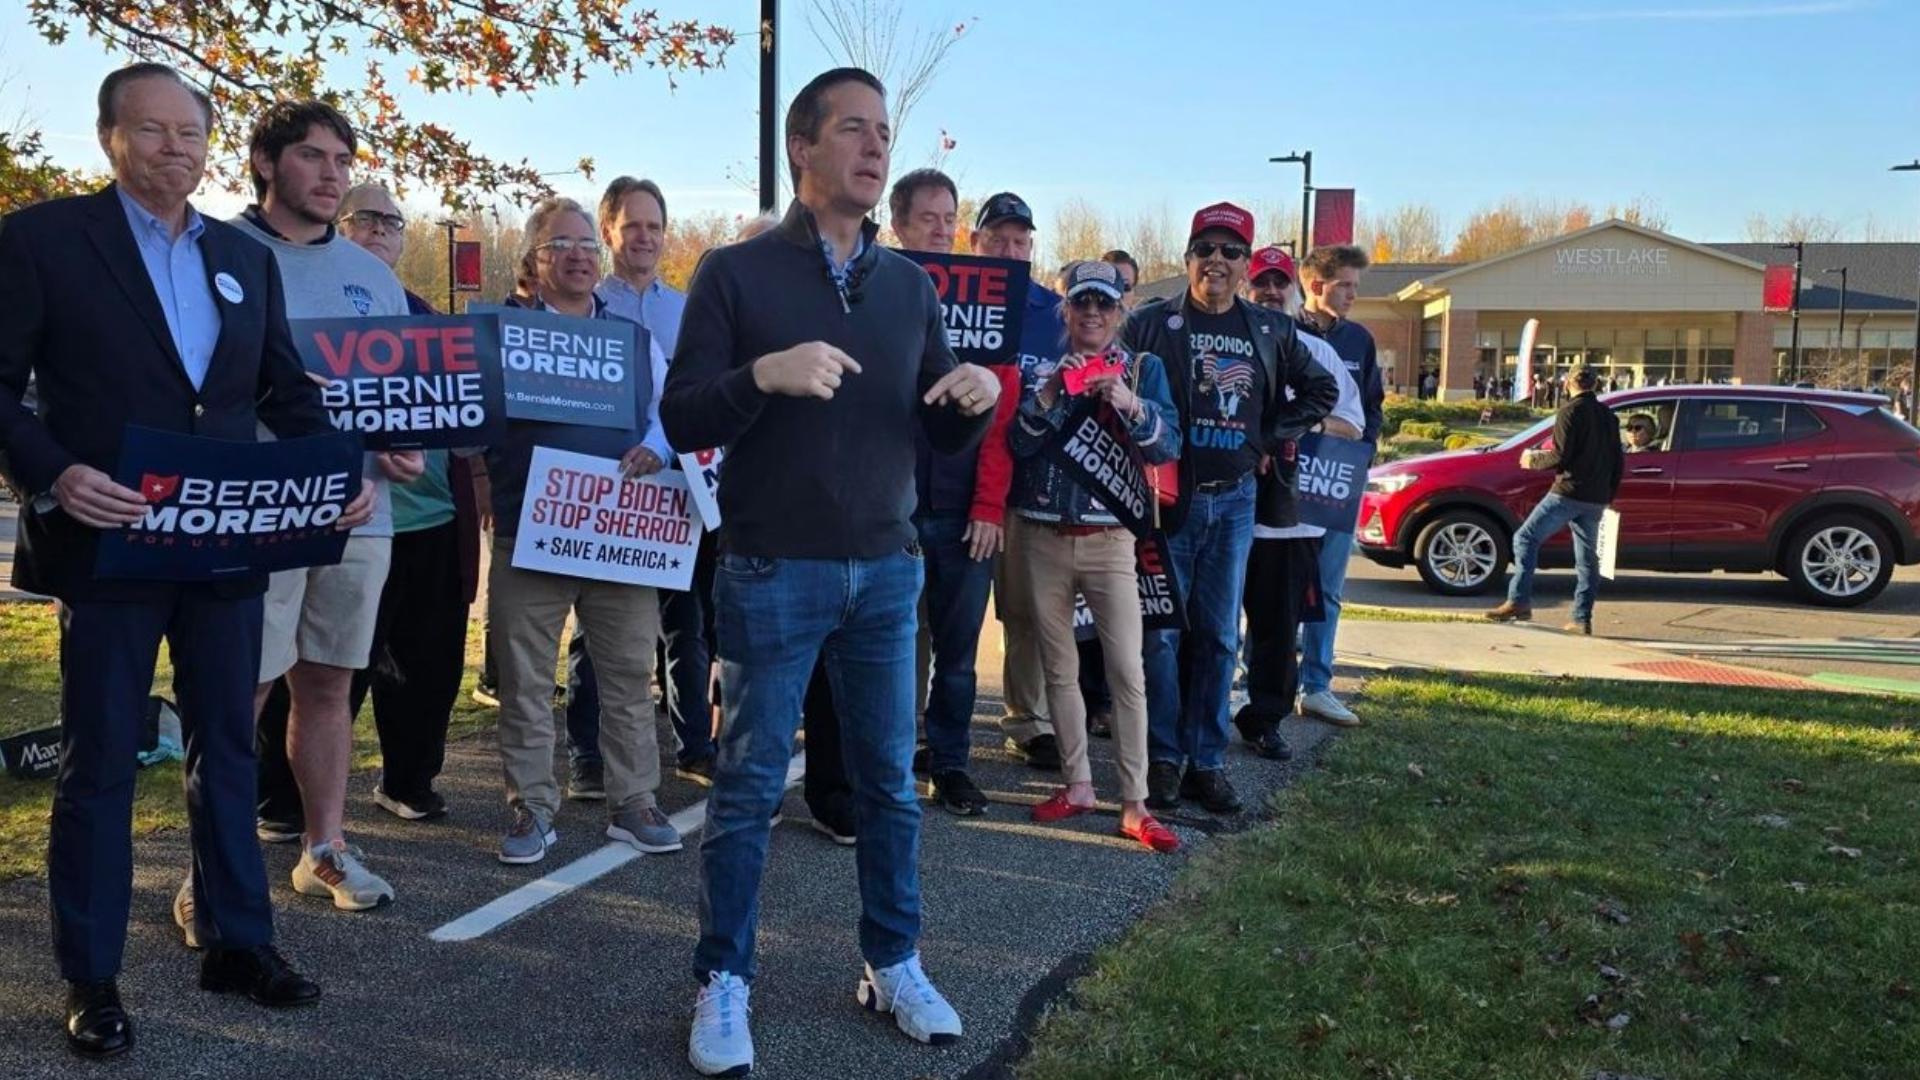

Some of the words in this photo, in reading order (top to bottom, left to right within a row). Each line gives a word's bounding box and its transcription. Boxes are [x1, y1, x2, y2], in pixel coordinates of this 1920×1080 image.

[1557, 248, 1668, 264] WESTLAKE
[313, 327, 478, 375] VOTE
[504, 324, 624, 361] BERNIE
[1189, 333, 1254, 357] REDONDO
[321, 373, 484, 407] BERNIE
[328, 403, 485, 432] MORENO
[1196, 418, 1216, 427] FOR
[1063, 435, 1145, 519] MORENO
[1077, 416, 1146, 504] BERNIE
[179, 473, 349, 506] BERNIE
[545, 467, 614, 505] STOP
[617, 480, 691, 519] BIDEN.
[1298, 473, 1350, 500] ENO
[129, 503, 342, 534] MORENO
[532, 497, 591, 530] STOP
[594, 508, 692, 546] SHERROD.
[551, 536, 594, 561] SAVE
[596, 544, 667, 570] AMERICA
